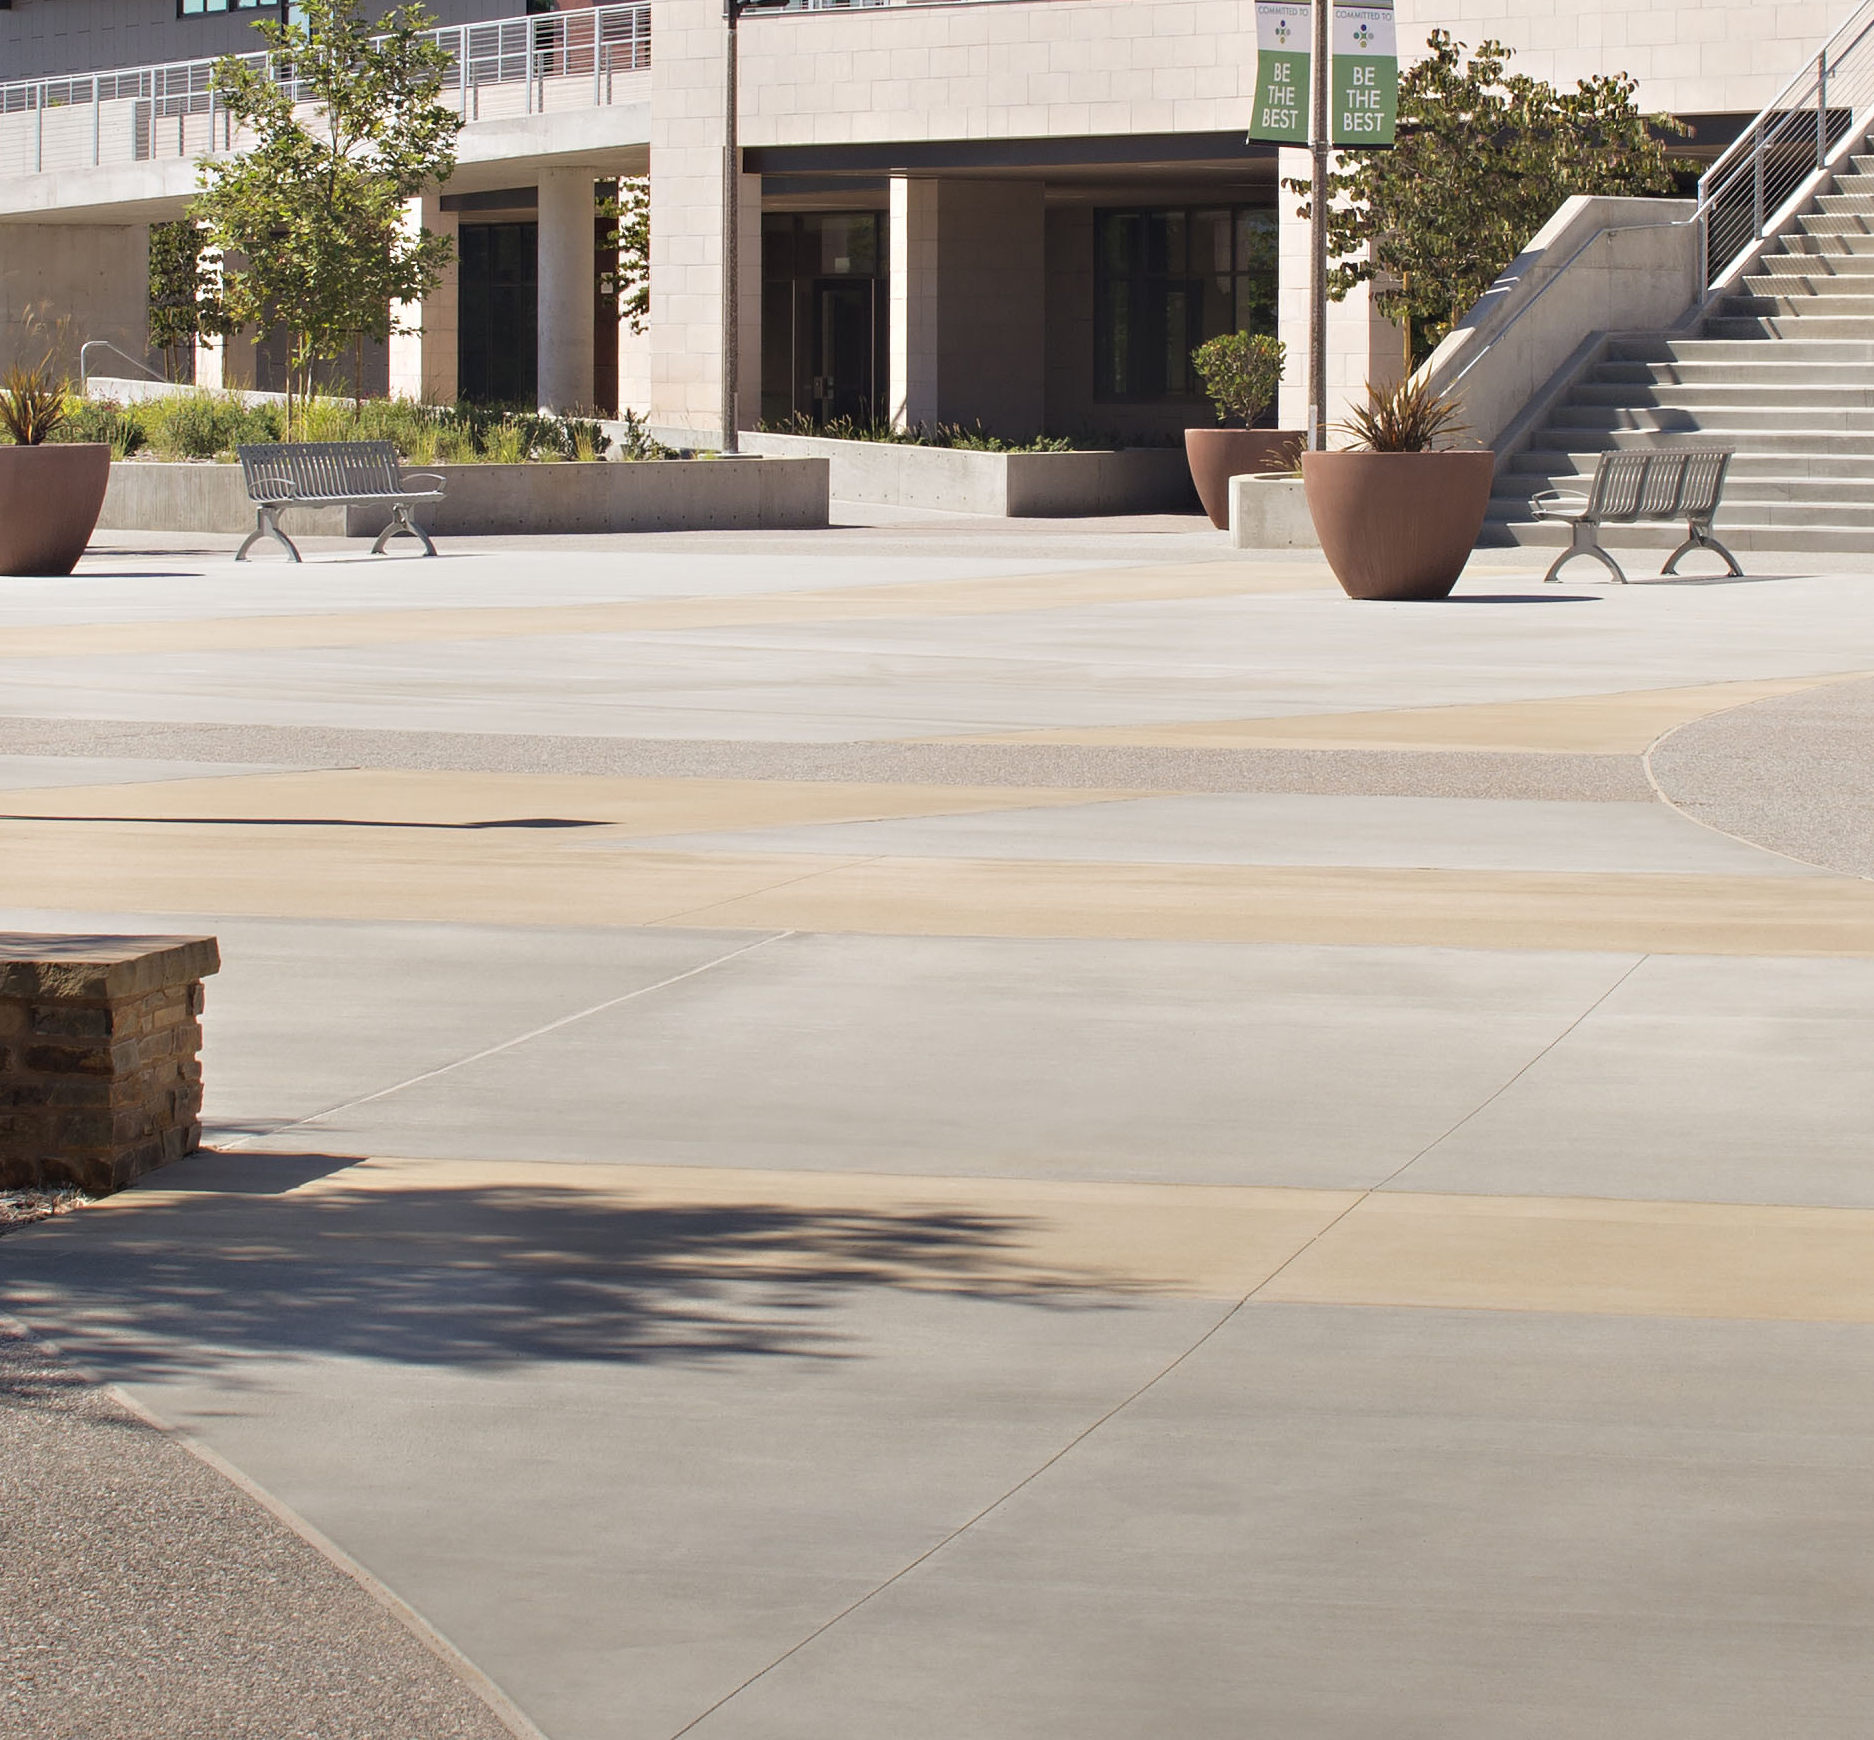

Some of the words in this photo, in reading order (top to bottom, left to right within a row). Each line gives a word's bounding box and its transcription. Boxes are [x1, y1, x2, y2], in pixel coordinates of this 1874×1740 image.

[1258, 6, 1298, 16] COMMITTED
[1299, 8, 1308, 17] TO
[1335, 10, 1380, 21] COMMITTED
[1381, 12, 1392, 21] TO
[1274, 63, 1291, 82] BE
[1353, 67, 1375, 86] BE
[1268, 85, 1295, 105] THE
[1346, 90, 1381, 109] THE
[1262, 108, 1298, 129] BEST
[1343, 113, 1385, 131] BEST
